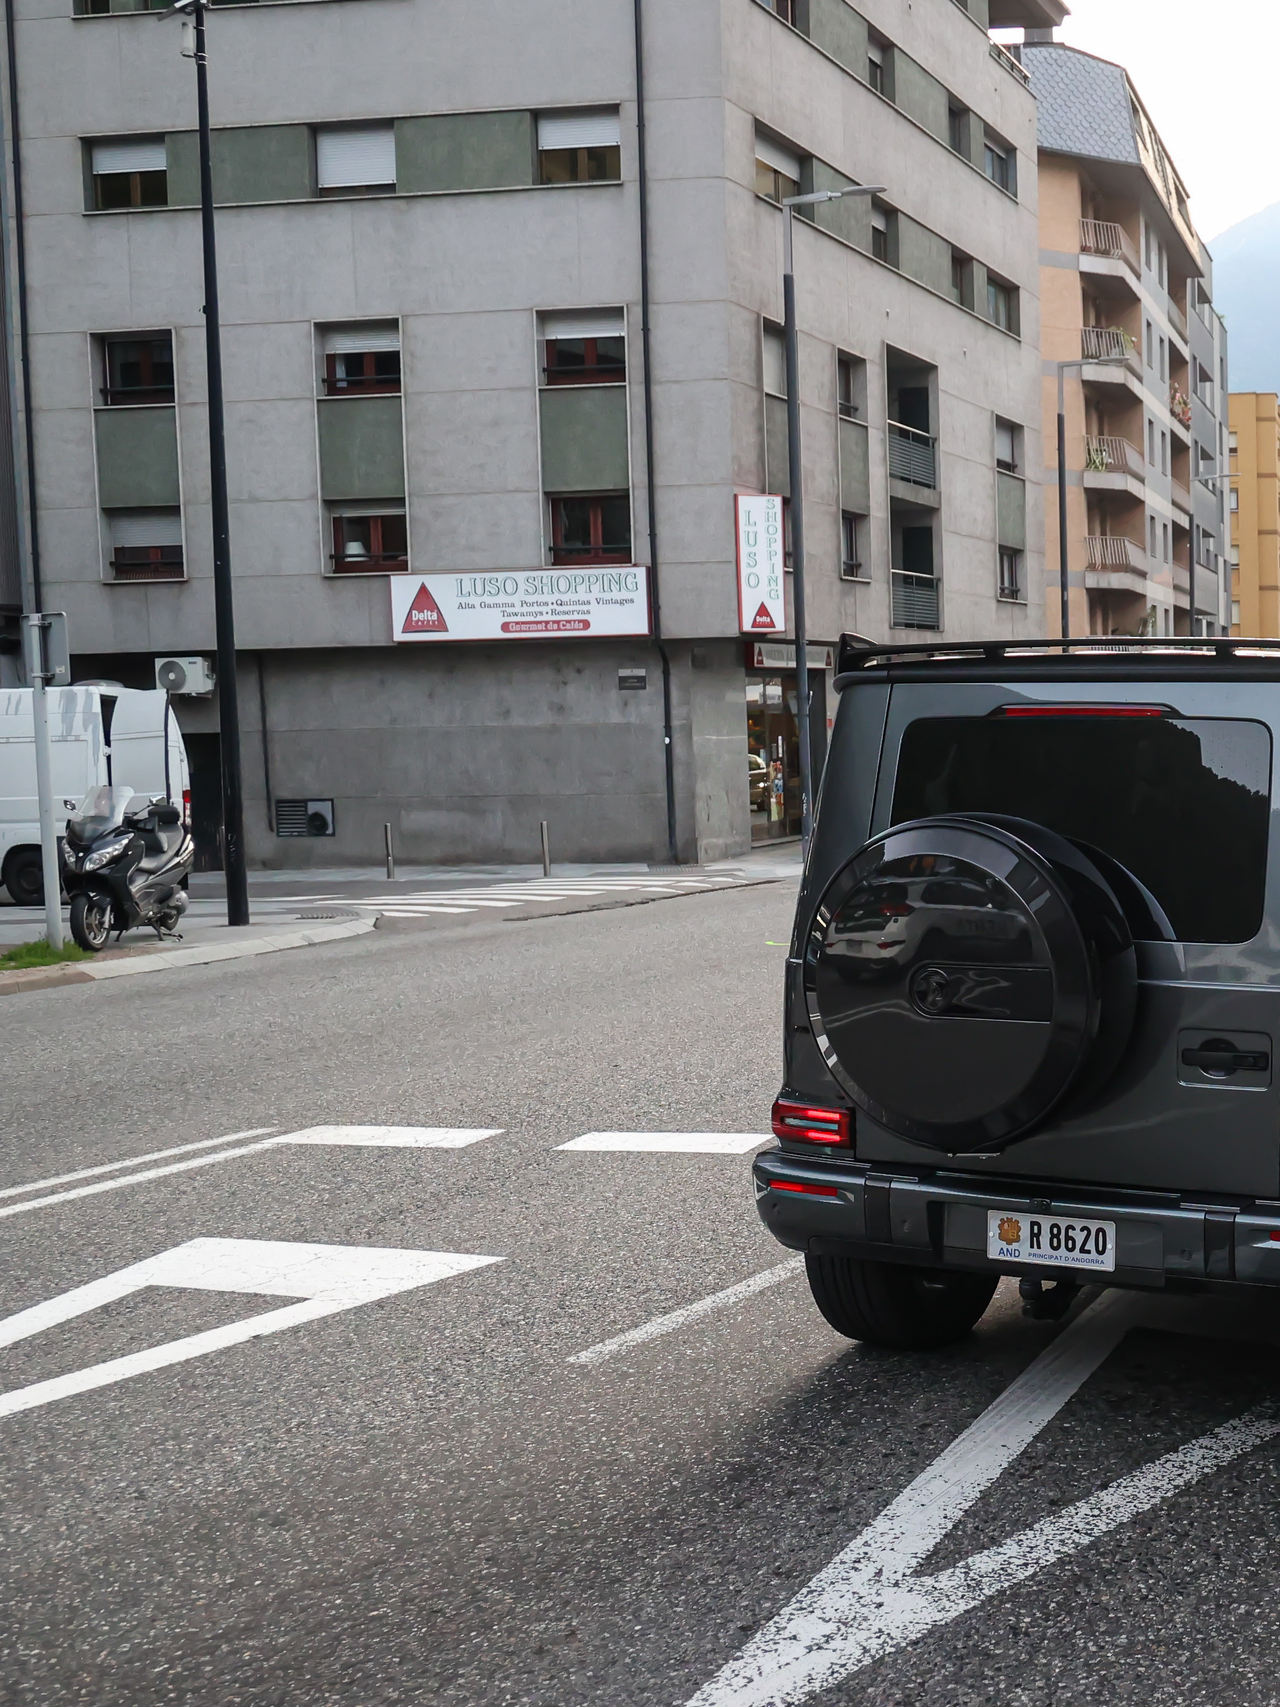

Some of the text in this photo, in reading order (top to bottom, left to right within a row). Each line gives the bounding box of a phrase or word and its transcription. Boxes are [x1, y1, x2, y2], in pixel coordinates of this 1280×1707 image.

[744, 510, 760, 589] LUSO
[764, 498, 779, 600] SHOPPING
[455, 572, 639, 598] LUSO SHOPPING
[457, 597, 635, 610] Alta Gamma Portos Quintas Vintages
[411, 609, 438, 621] Delta
[500, 608, 591, 618] Tawamys Reservas
[508, 622, 546, 631] Gourmet
[547, 622, 558, 630] de
[998, 1247, 1021, 1258] AND
[1028, 1252, 1105, 1265] PRINCIPAT D'ANDORRA
